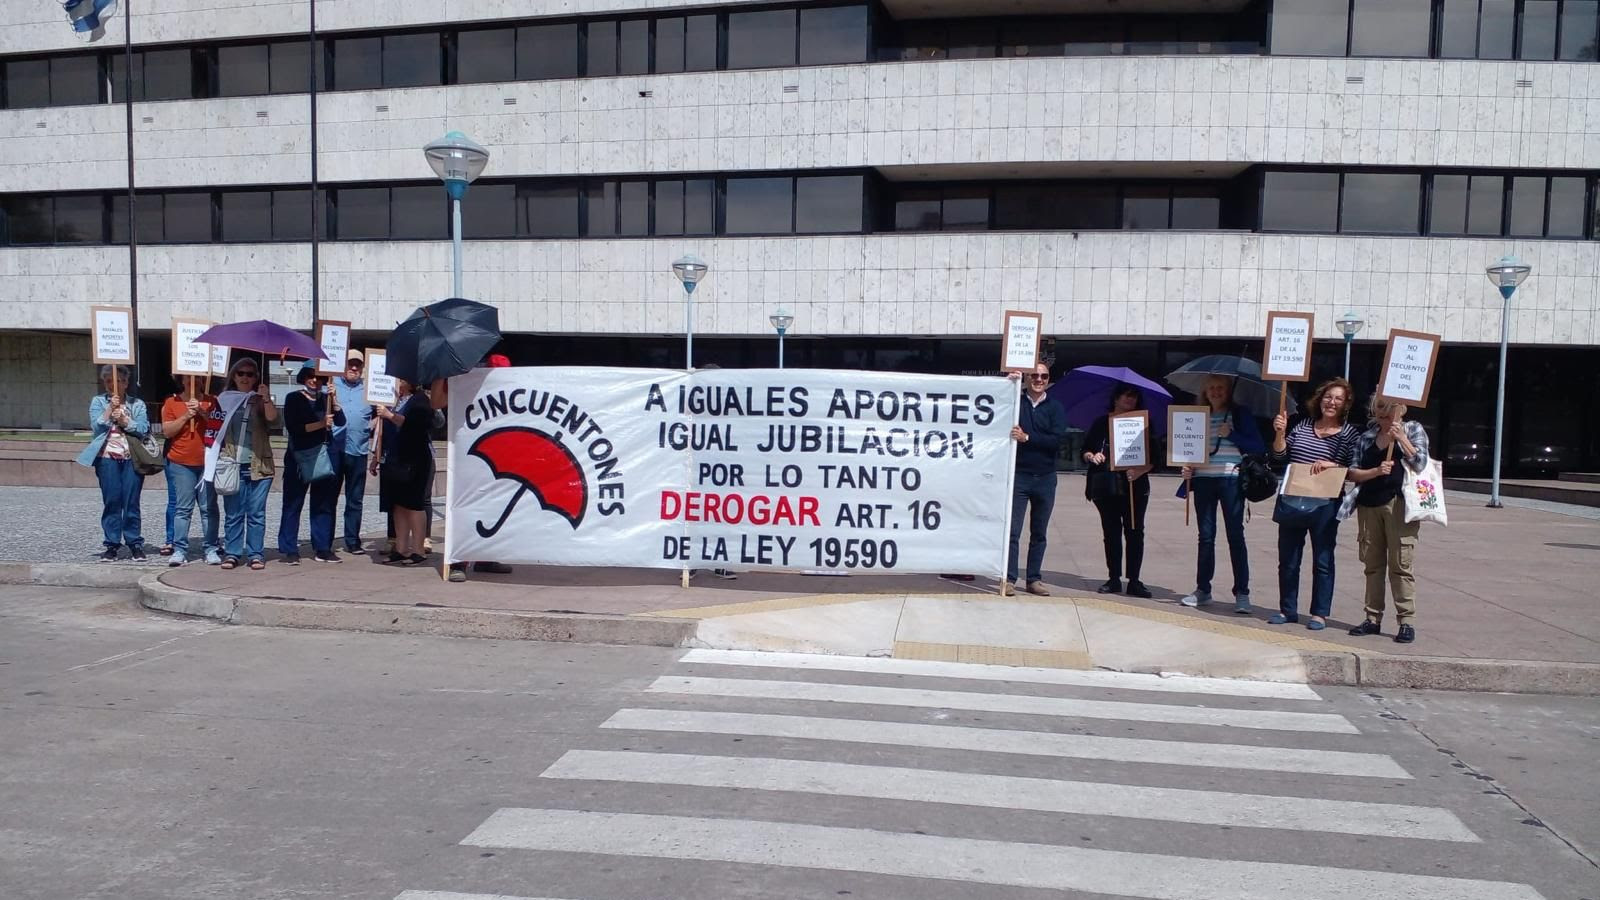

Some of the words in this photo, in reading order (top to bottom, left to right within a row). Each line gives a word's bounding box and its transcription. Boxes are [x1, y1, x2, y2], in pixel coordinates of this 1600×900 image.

[1391, 362, 1426, 372] DECUENTO
[644, 384, 667, 412] A
[679, 385, 809, 417] IGUALES
[827, 388, 995, 426] APORTES
[465, 388, 625, 516] CINCUENTONES
[658, 422, 738, 451] IGUAL
[757, 424, 974, 459] JUBILACION
[699, 463, 744, 486] POR
[765, 464, 802, 488] LO
[818, 465, 921, 491] TANTO
[660, 490, 821, 526] DEROGAR
[835, 503, 899, 529] ART.
[908, 500, 942, 530] 16
[663, 536, 690, 560] DE
[702, 536, 729, 561] LA
[740, 534, 796, 566] LEY
[810, 537, 898, 568] 19590
